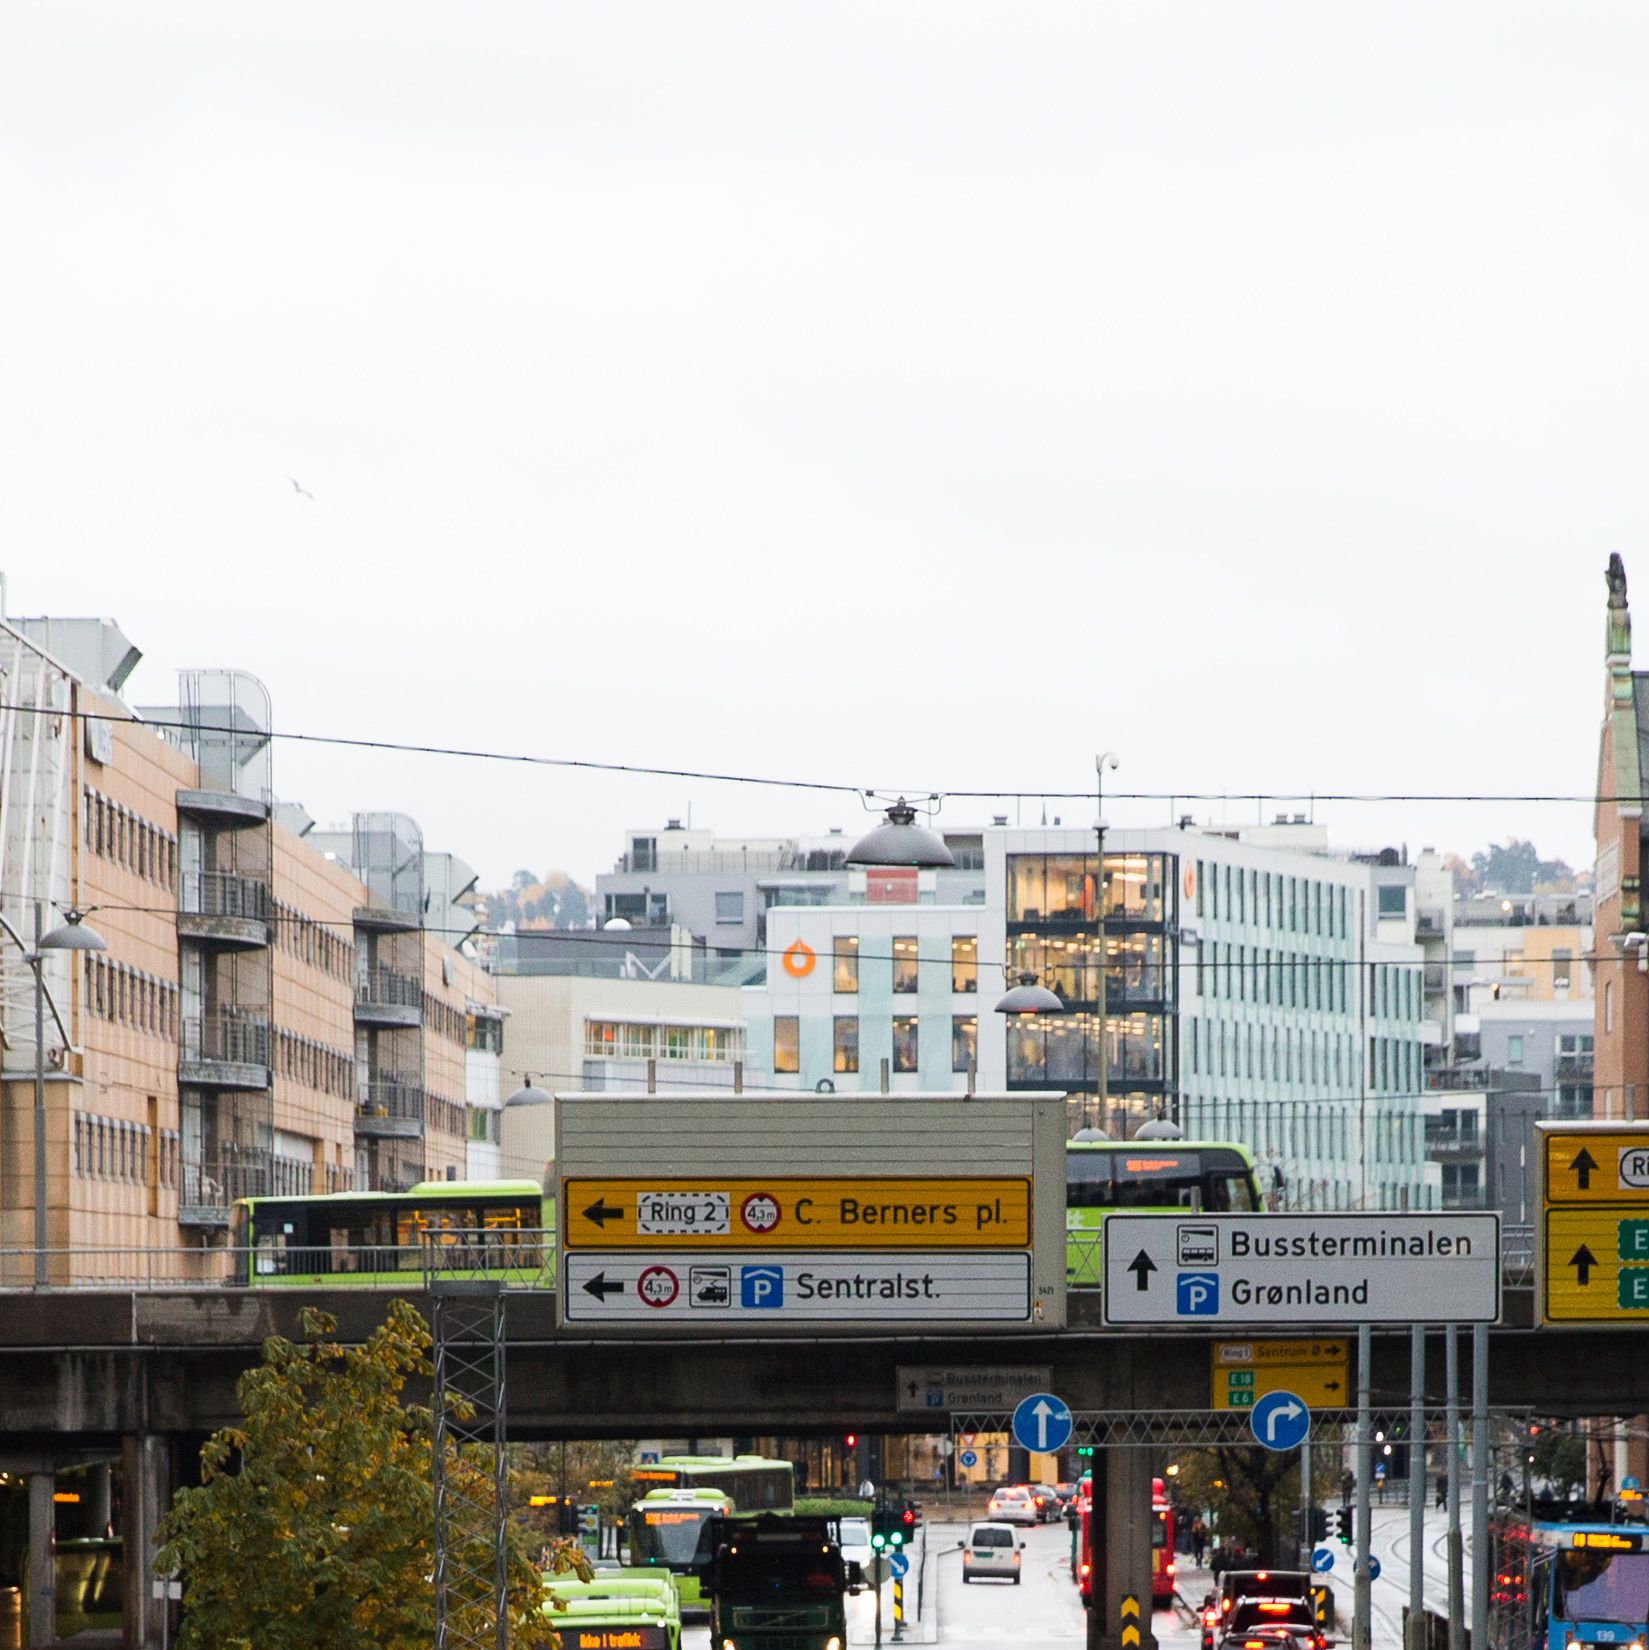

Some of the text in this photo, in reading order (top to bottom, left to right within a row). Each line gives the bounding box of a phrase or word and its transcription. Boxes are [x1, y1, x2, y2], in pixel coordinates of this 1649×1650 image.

[650, 1201, 695, 1224] Ring
[704, 1202, 716, 1221] 2
[794, 1199, 821, 1225] C.
[840, 1199, 958, 1225] Berners
[975, 1198, 1009, 1231] pl.
[1232, 1230, 1472, 1257] Bussterminalen
[1634, 1229, 1648, 1250] E
[796, 1273, 941, 1300] Sentralst.
[1232, 1279, 1368, 1306] Grønland
[1633, 1279, 1647, 1299] E
[1257, 1346, 1307, 1357] Sentrum
[946, 1372, 1042, 1385] Bussterminalen
